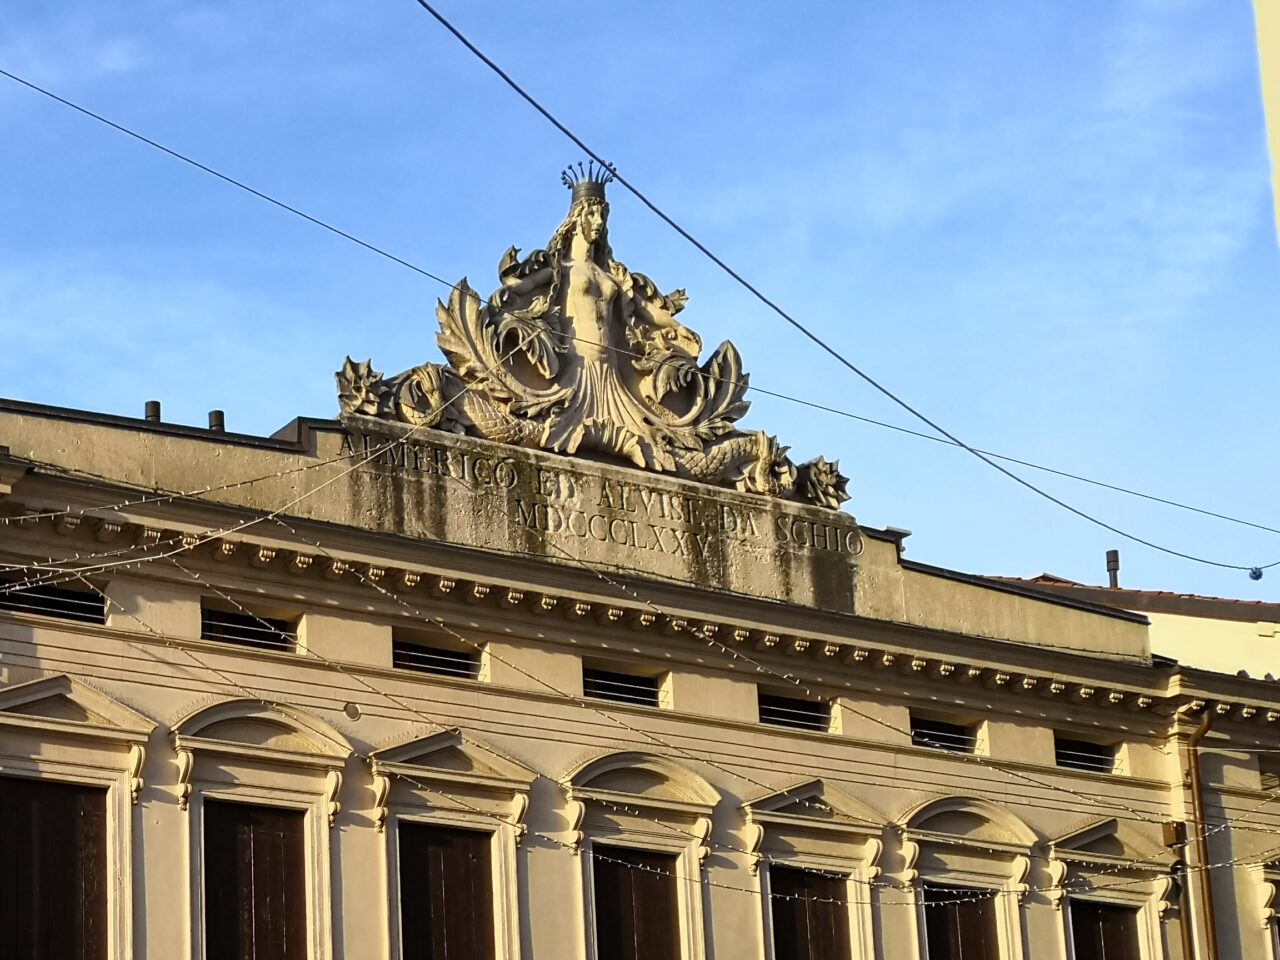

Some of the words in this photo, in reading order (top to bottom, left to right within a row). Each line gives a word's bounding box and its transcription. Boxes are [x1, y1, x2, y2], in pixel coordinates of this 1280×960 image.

[596, 479, 704, 526] ALVISE
[718, 504, 762, 540] DA
[776, 515, 865, 557] SCHIO
